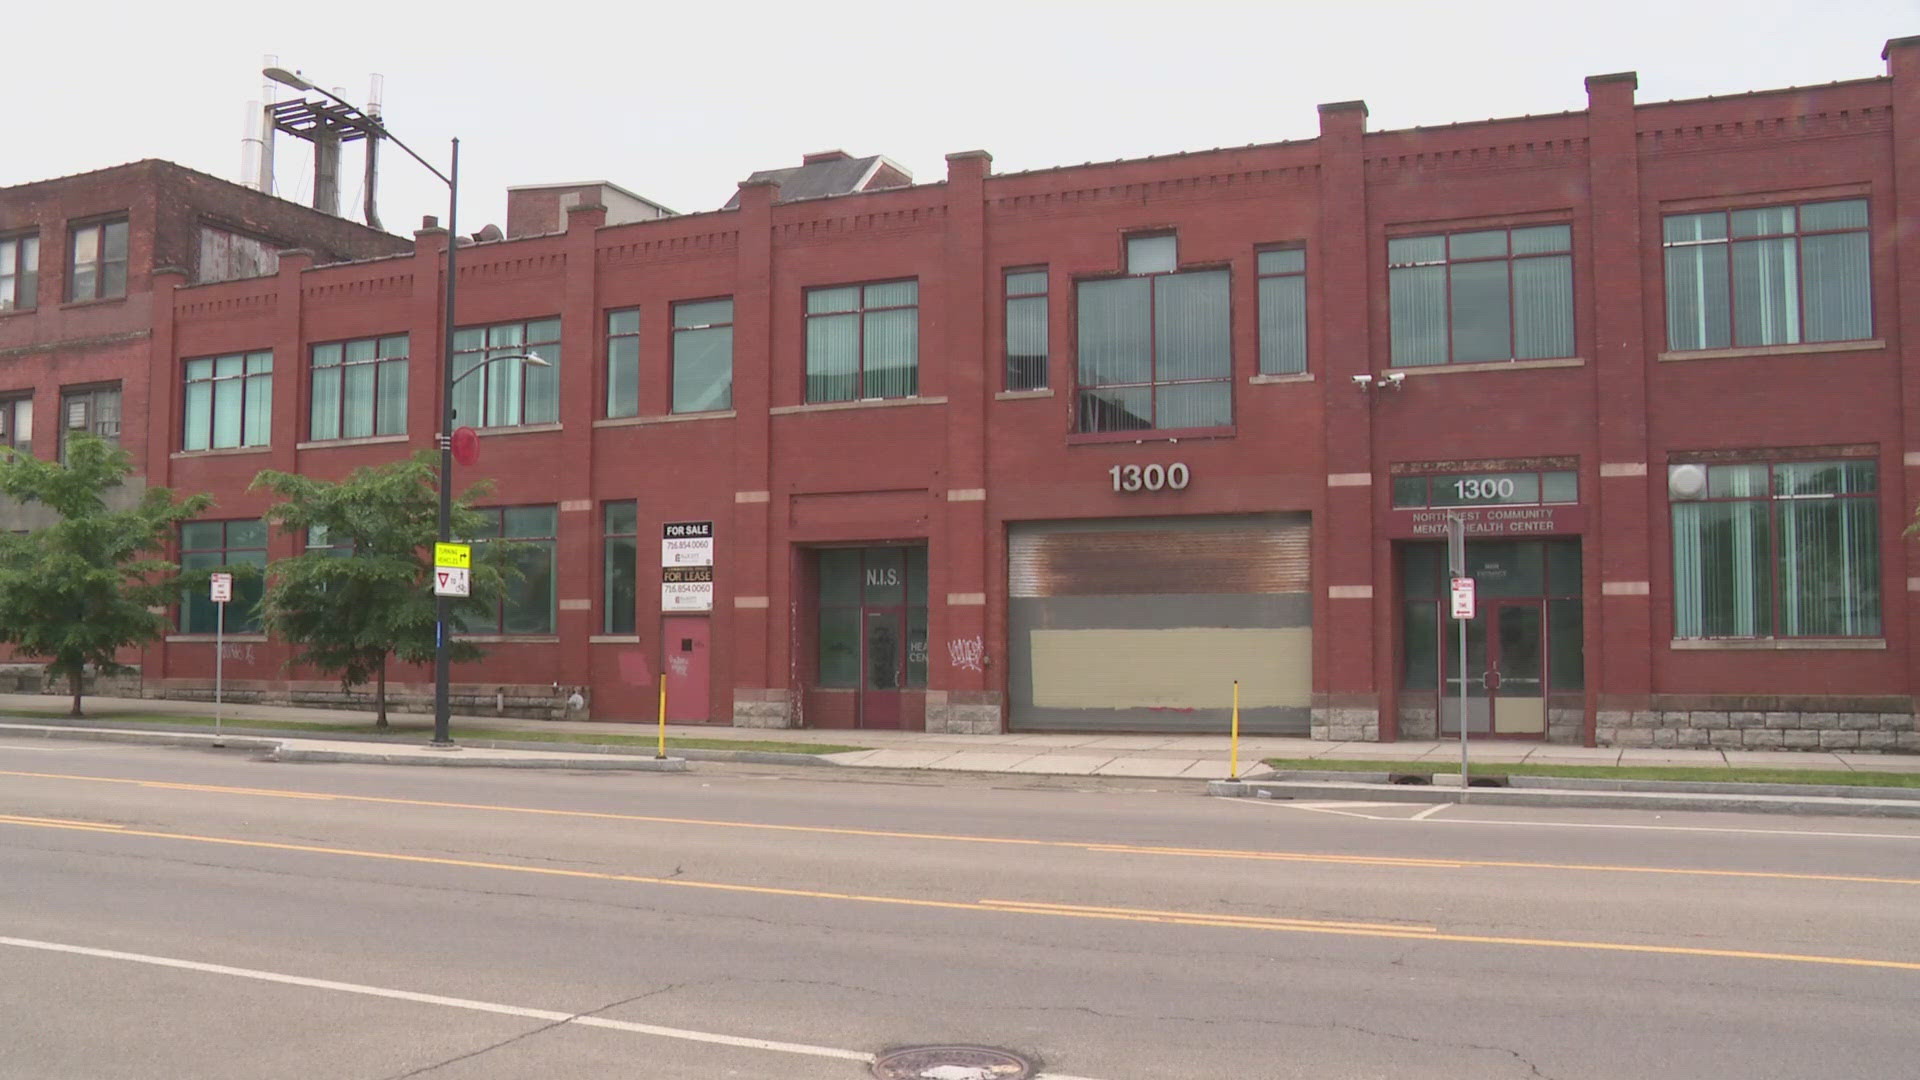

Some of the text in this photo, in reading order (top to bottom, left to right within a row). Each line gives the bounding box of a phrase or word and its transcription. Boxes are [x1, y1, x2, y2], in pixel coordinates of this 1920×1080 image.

[1108, 462, 1190, 492] 1300
[1453, 478, 1514, 499] 1300
[1487, 509, 1553, 520] COMMUNITY
[666, 525, 709, 536] FOR SALE
[1413, 524, 1449, 534] MENTA
[1509, 521, 1554, 531] CENTER
[664, 572, 711, 582] FOR LEASE
[866, 568, 901, 586] N.I.S.
